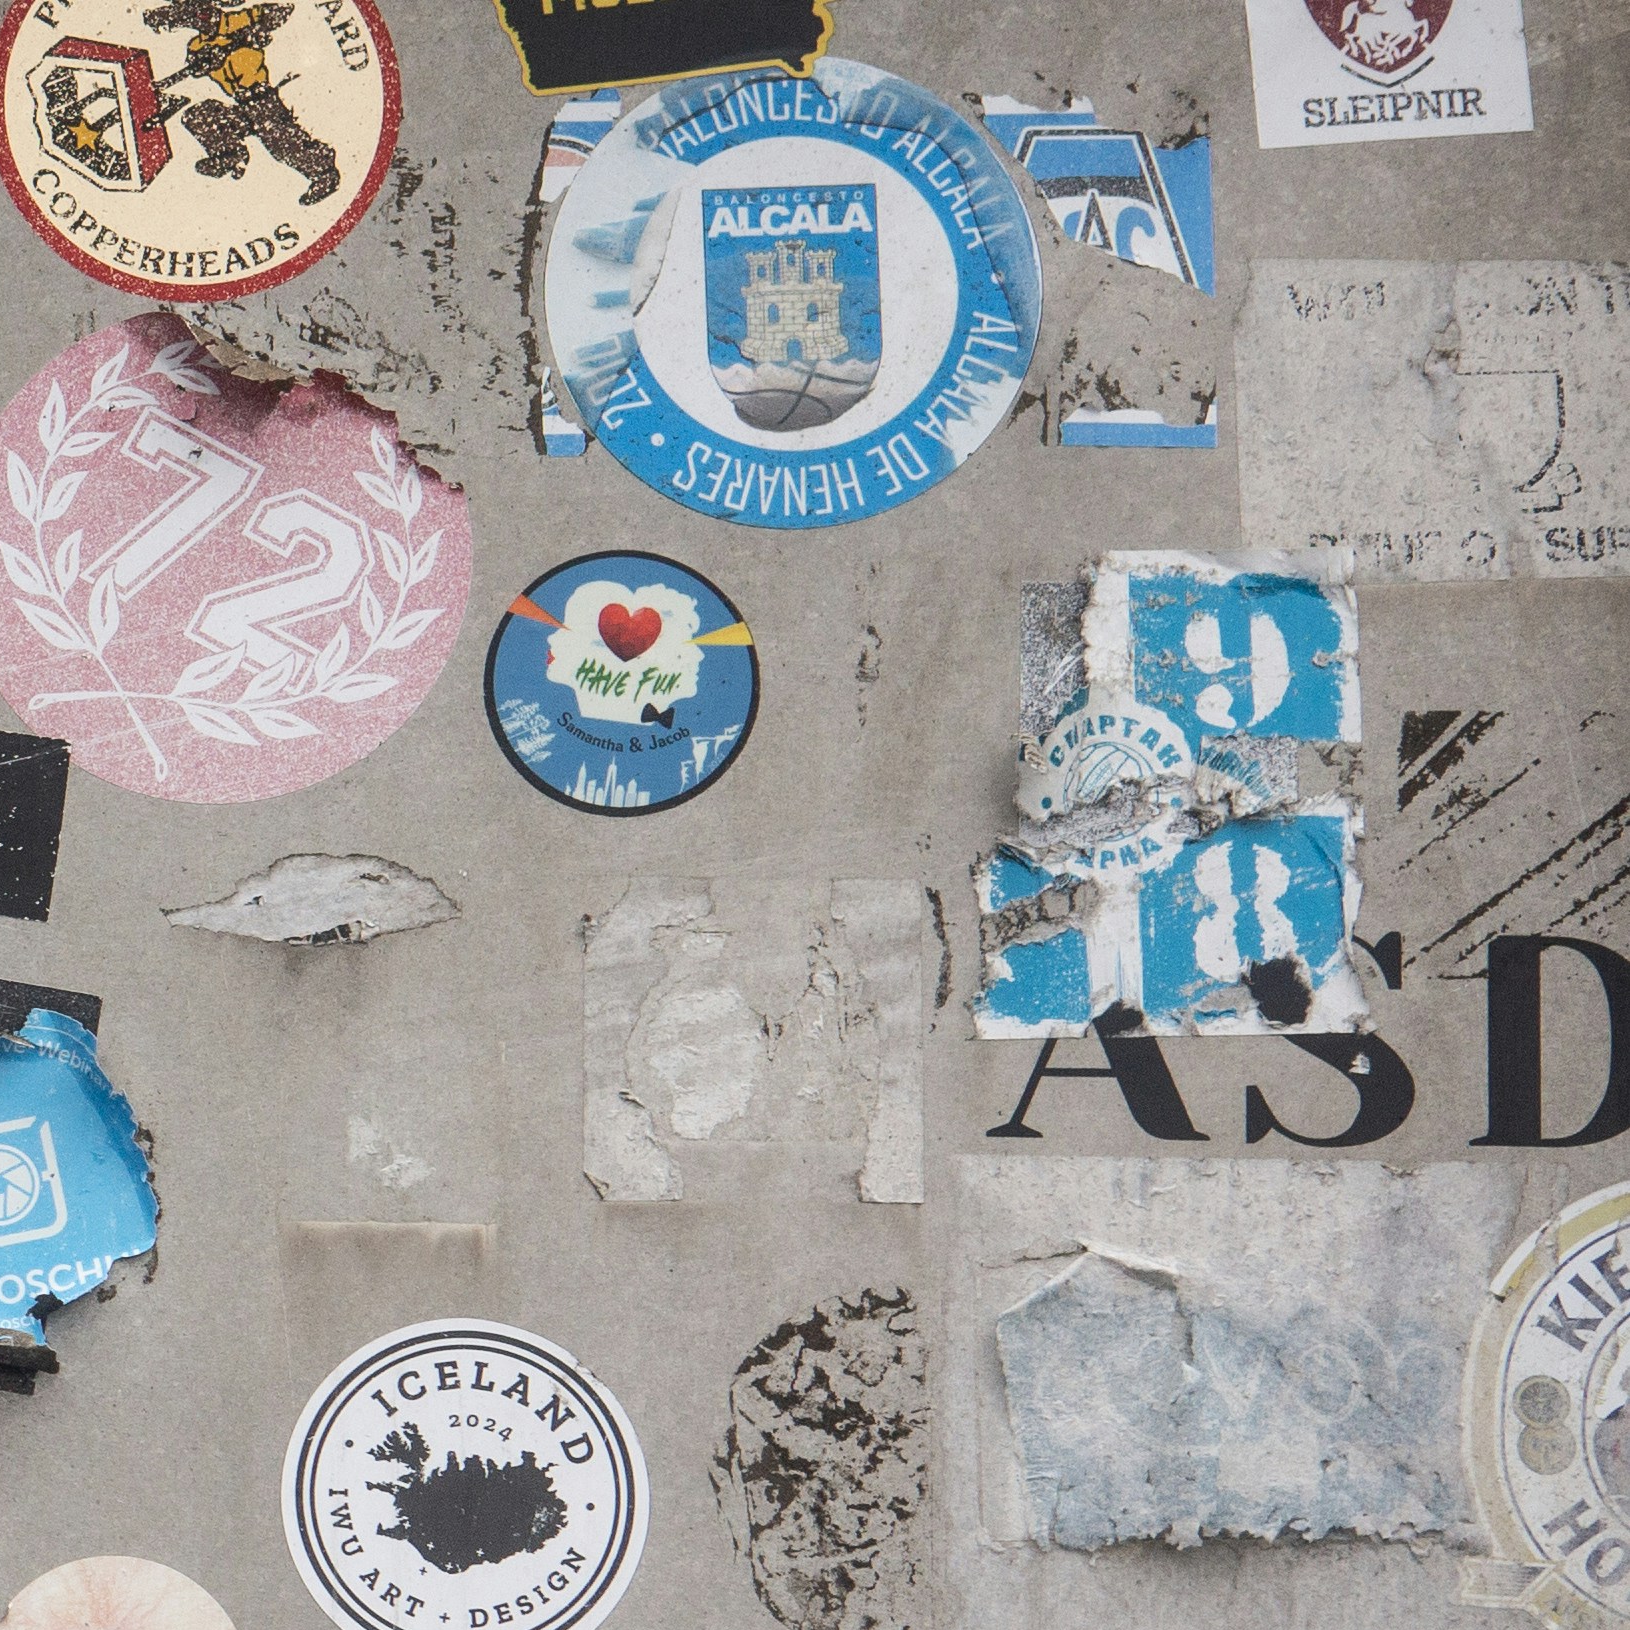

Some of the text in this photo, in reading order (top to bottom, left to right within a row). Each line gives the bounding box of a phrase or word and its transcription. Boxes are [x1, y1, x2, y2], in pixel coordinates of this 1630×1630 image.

[1304, 88, 1486, 129] SLEIPNIR
[708, 203, 872, 238] ALCALA
[713, 190, 867, 206] BALONCESTO
[32, 169, 301, 278] COPPERHEADS
[674, 440, 864, 517] HENARES
[866, 429, 929, 484] DE
[575, 658, 628, 698] HAVE
[557, 711, 691, 754] Samantha & Jacob
[1047, 715, 1183, 769] СПАРТАК
[372, 1361, 594, 1465] ICELAND
[448, 1413, 514, 1443] 2024
[360, 1567, 425, 1619] ART
[469, 1547, 587, 1630] DESIGN
